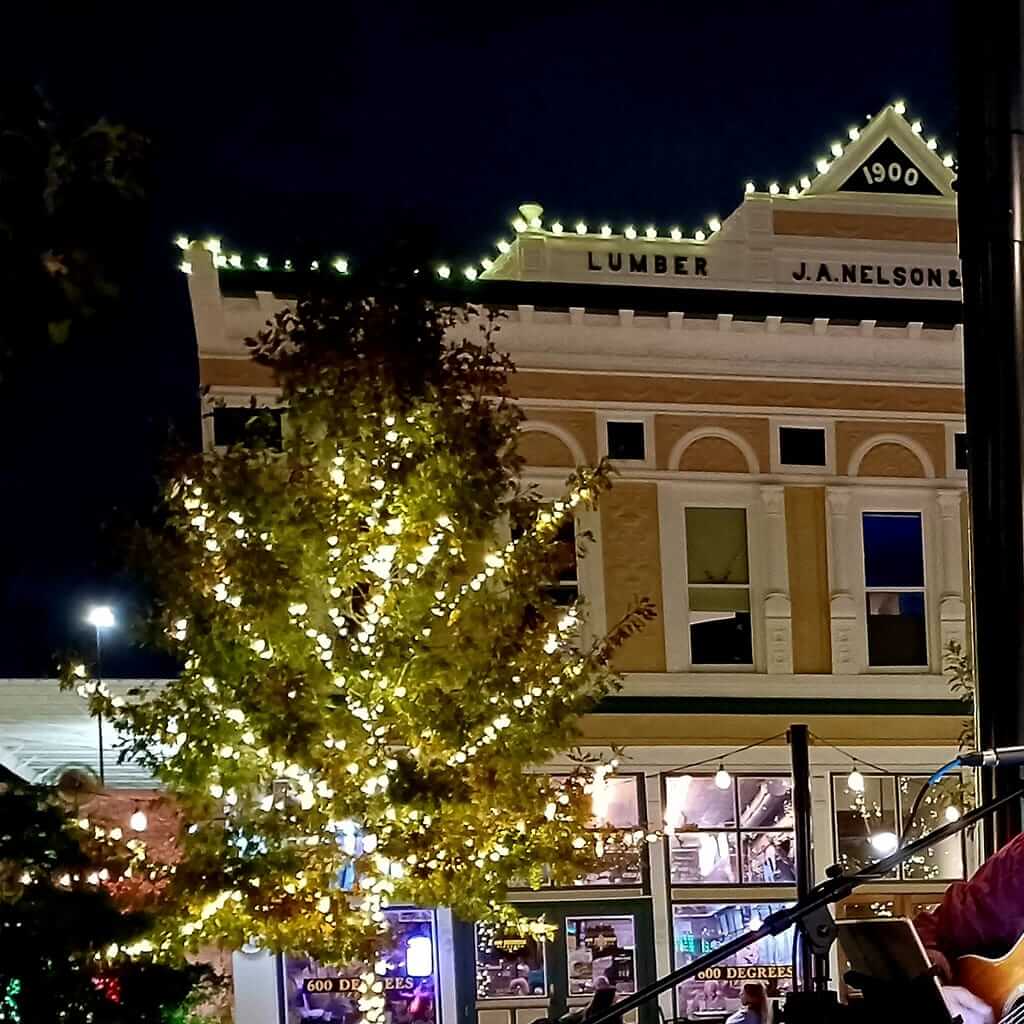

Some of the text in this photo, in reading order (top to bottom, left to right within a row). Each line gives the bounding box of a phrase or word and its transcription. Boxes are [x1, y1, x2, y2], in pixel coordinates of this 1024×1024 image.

[863, 163, 918, 186] 1900
[588, 251, 707, 276] LUMBER
[727, 967, 792, 979] DEGREES
[307, 977, 414, 992] 600 DEEES
